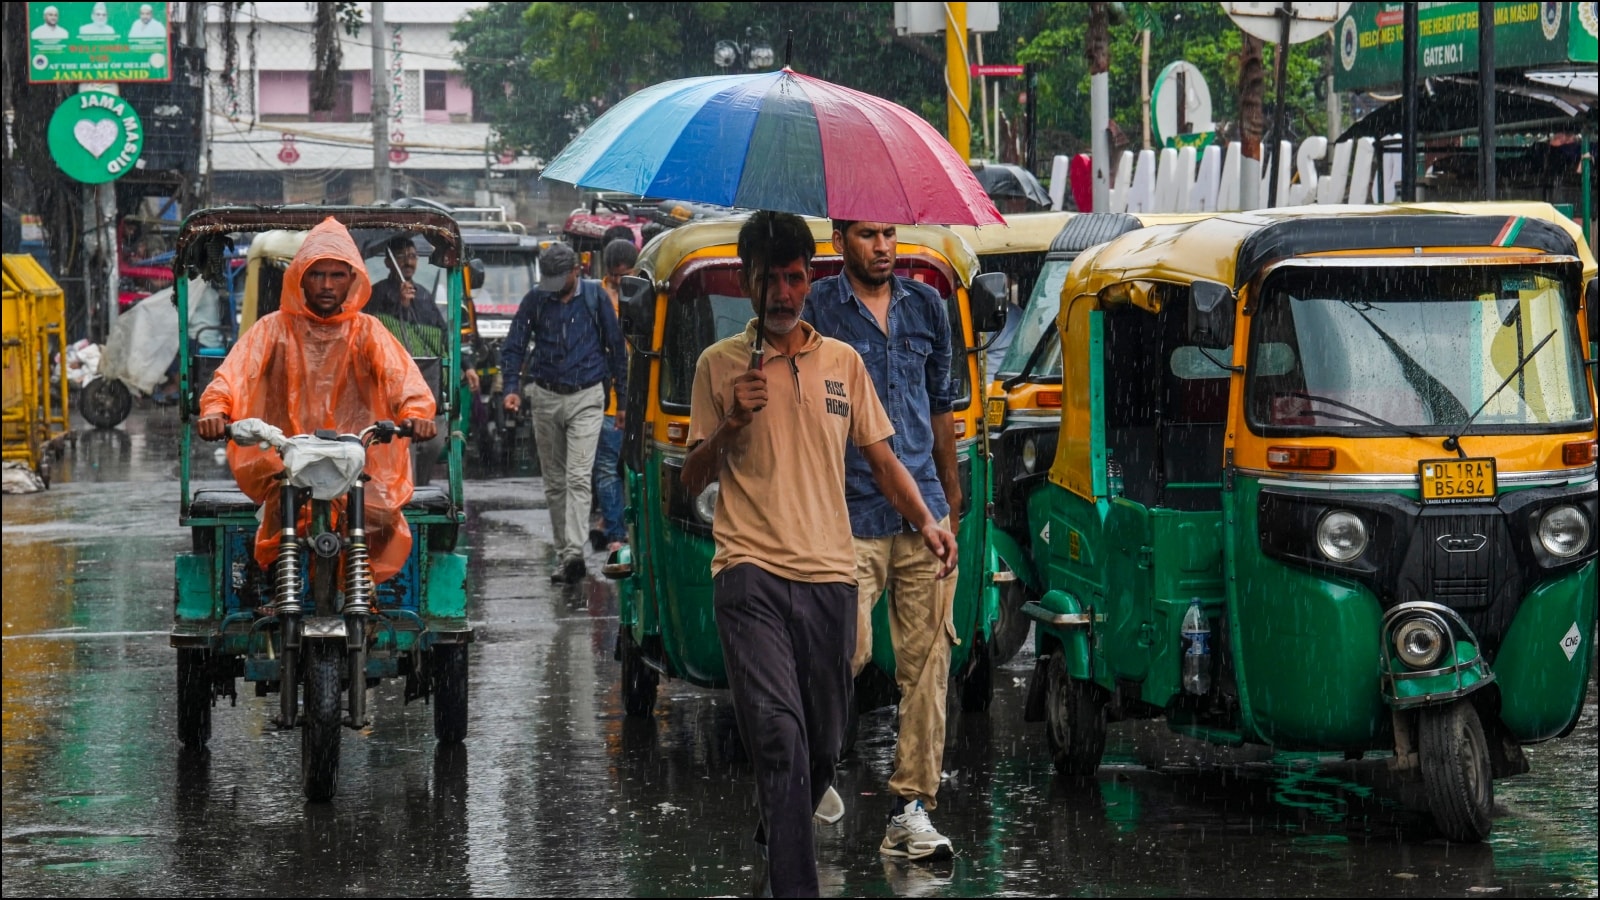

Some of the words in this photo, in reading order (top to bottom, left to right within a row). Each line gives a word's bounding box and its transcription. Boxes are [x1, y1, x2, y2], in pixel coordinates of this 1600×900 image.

[1419, 18, 1433, 36] THE
[1433, 14, 1455, 34] HEART
[1456, 12, 1466, 31] OF
[1510, 3, 1538, 23] MASJID
[1423, 46, 1443, 67] GATE
[1444, 45, 1459, 64] NO.
[1459, 43, 1464, 62] 1
[53, 71, 94, 80] JAMA
[96, 70, 149, 80] MASJID
[81, 94, 125, 116] JAMA
[107, 116, 139, 174] MASJID
[824, 380, 846, 397] RISE
[1435, 480, 1485, 496] B5494
[1565, 635, 1578, 647] CNG
